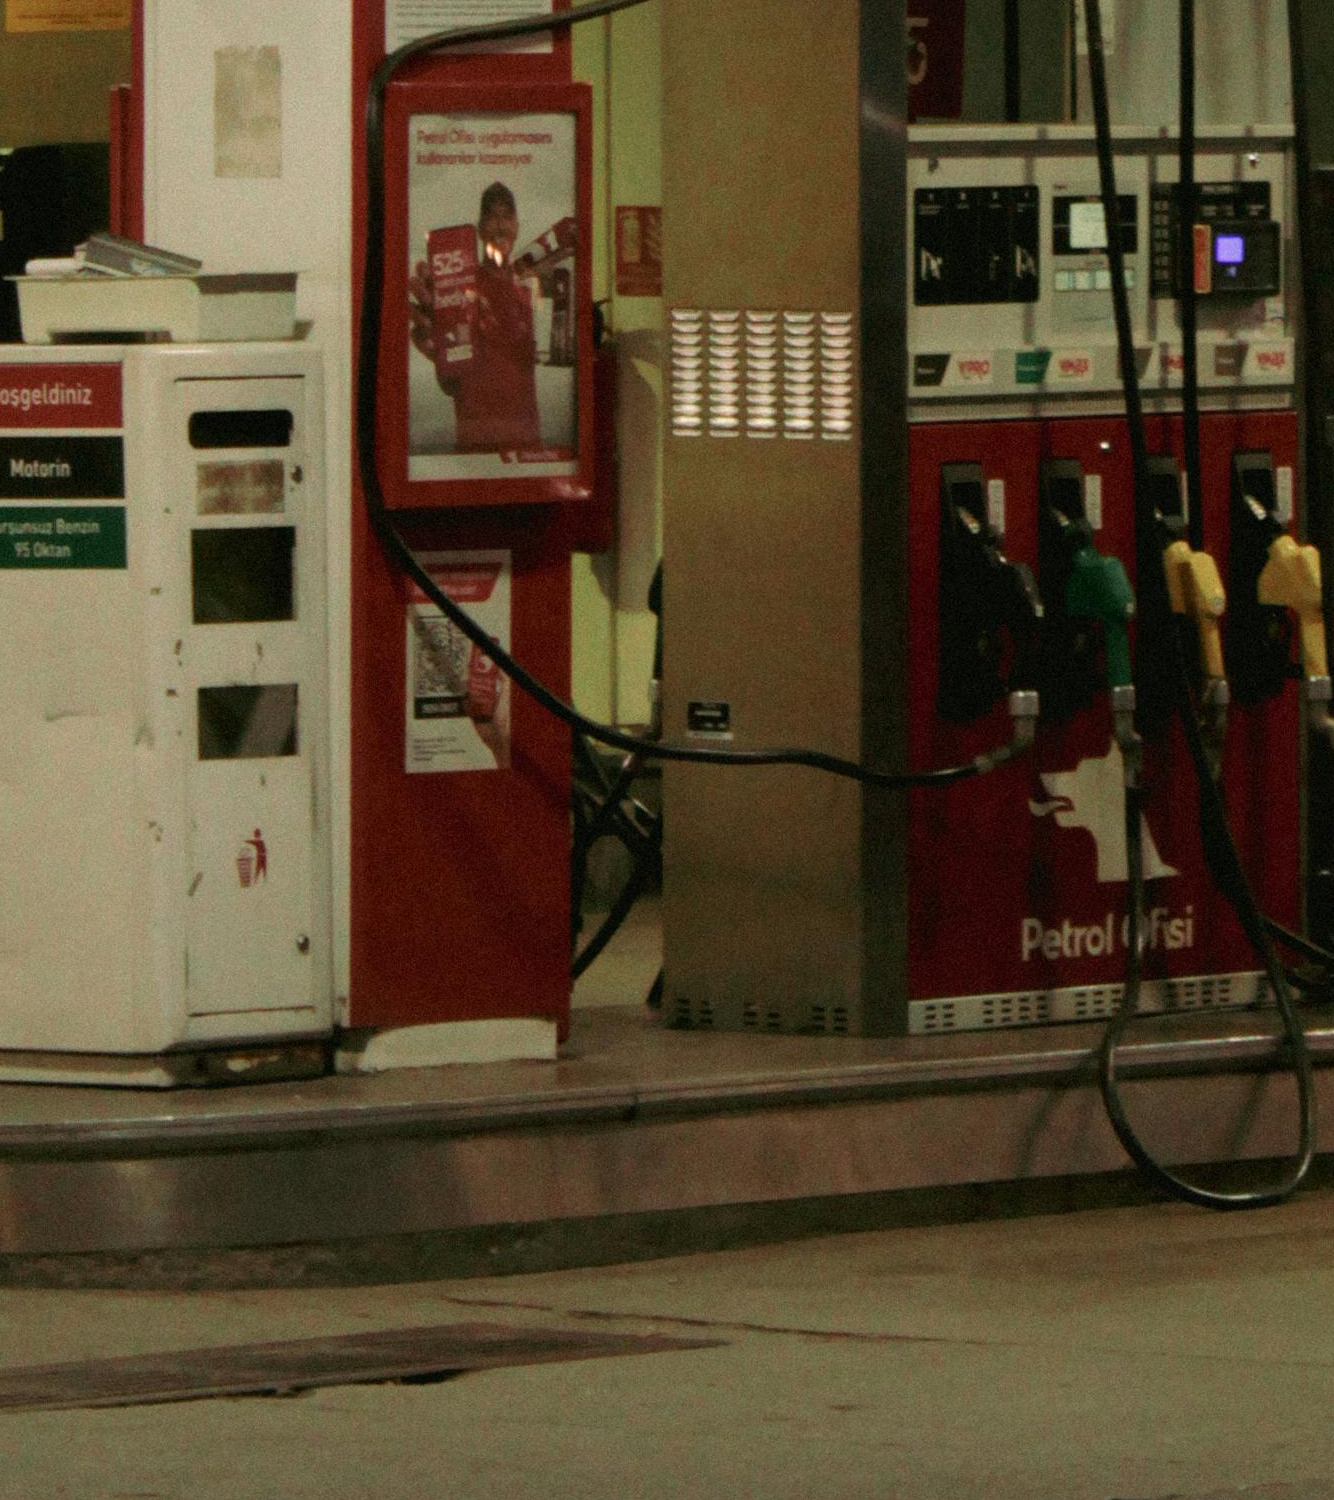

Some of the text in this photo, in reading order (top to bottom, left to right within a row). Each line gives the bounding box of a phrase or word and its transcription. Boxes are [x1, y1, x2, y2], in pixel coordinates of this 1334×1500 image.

[432, 249, 464, 276] 525
[9, 457, 72, 478] Motorin
[15, 541, 72, 558] 95 Oktan
[1021, 911, 1114, 962] Petrol
